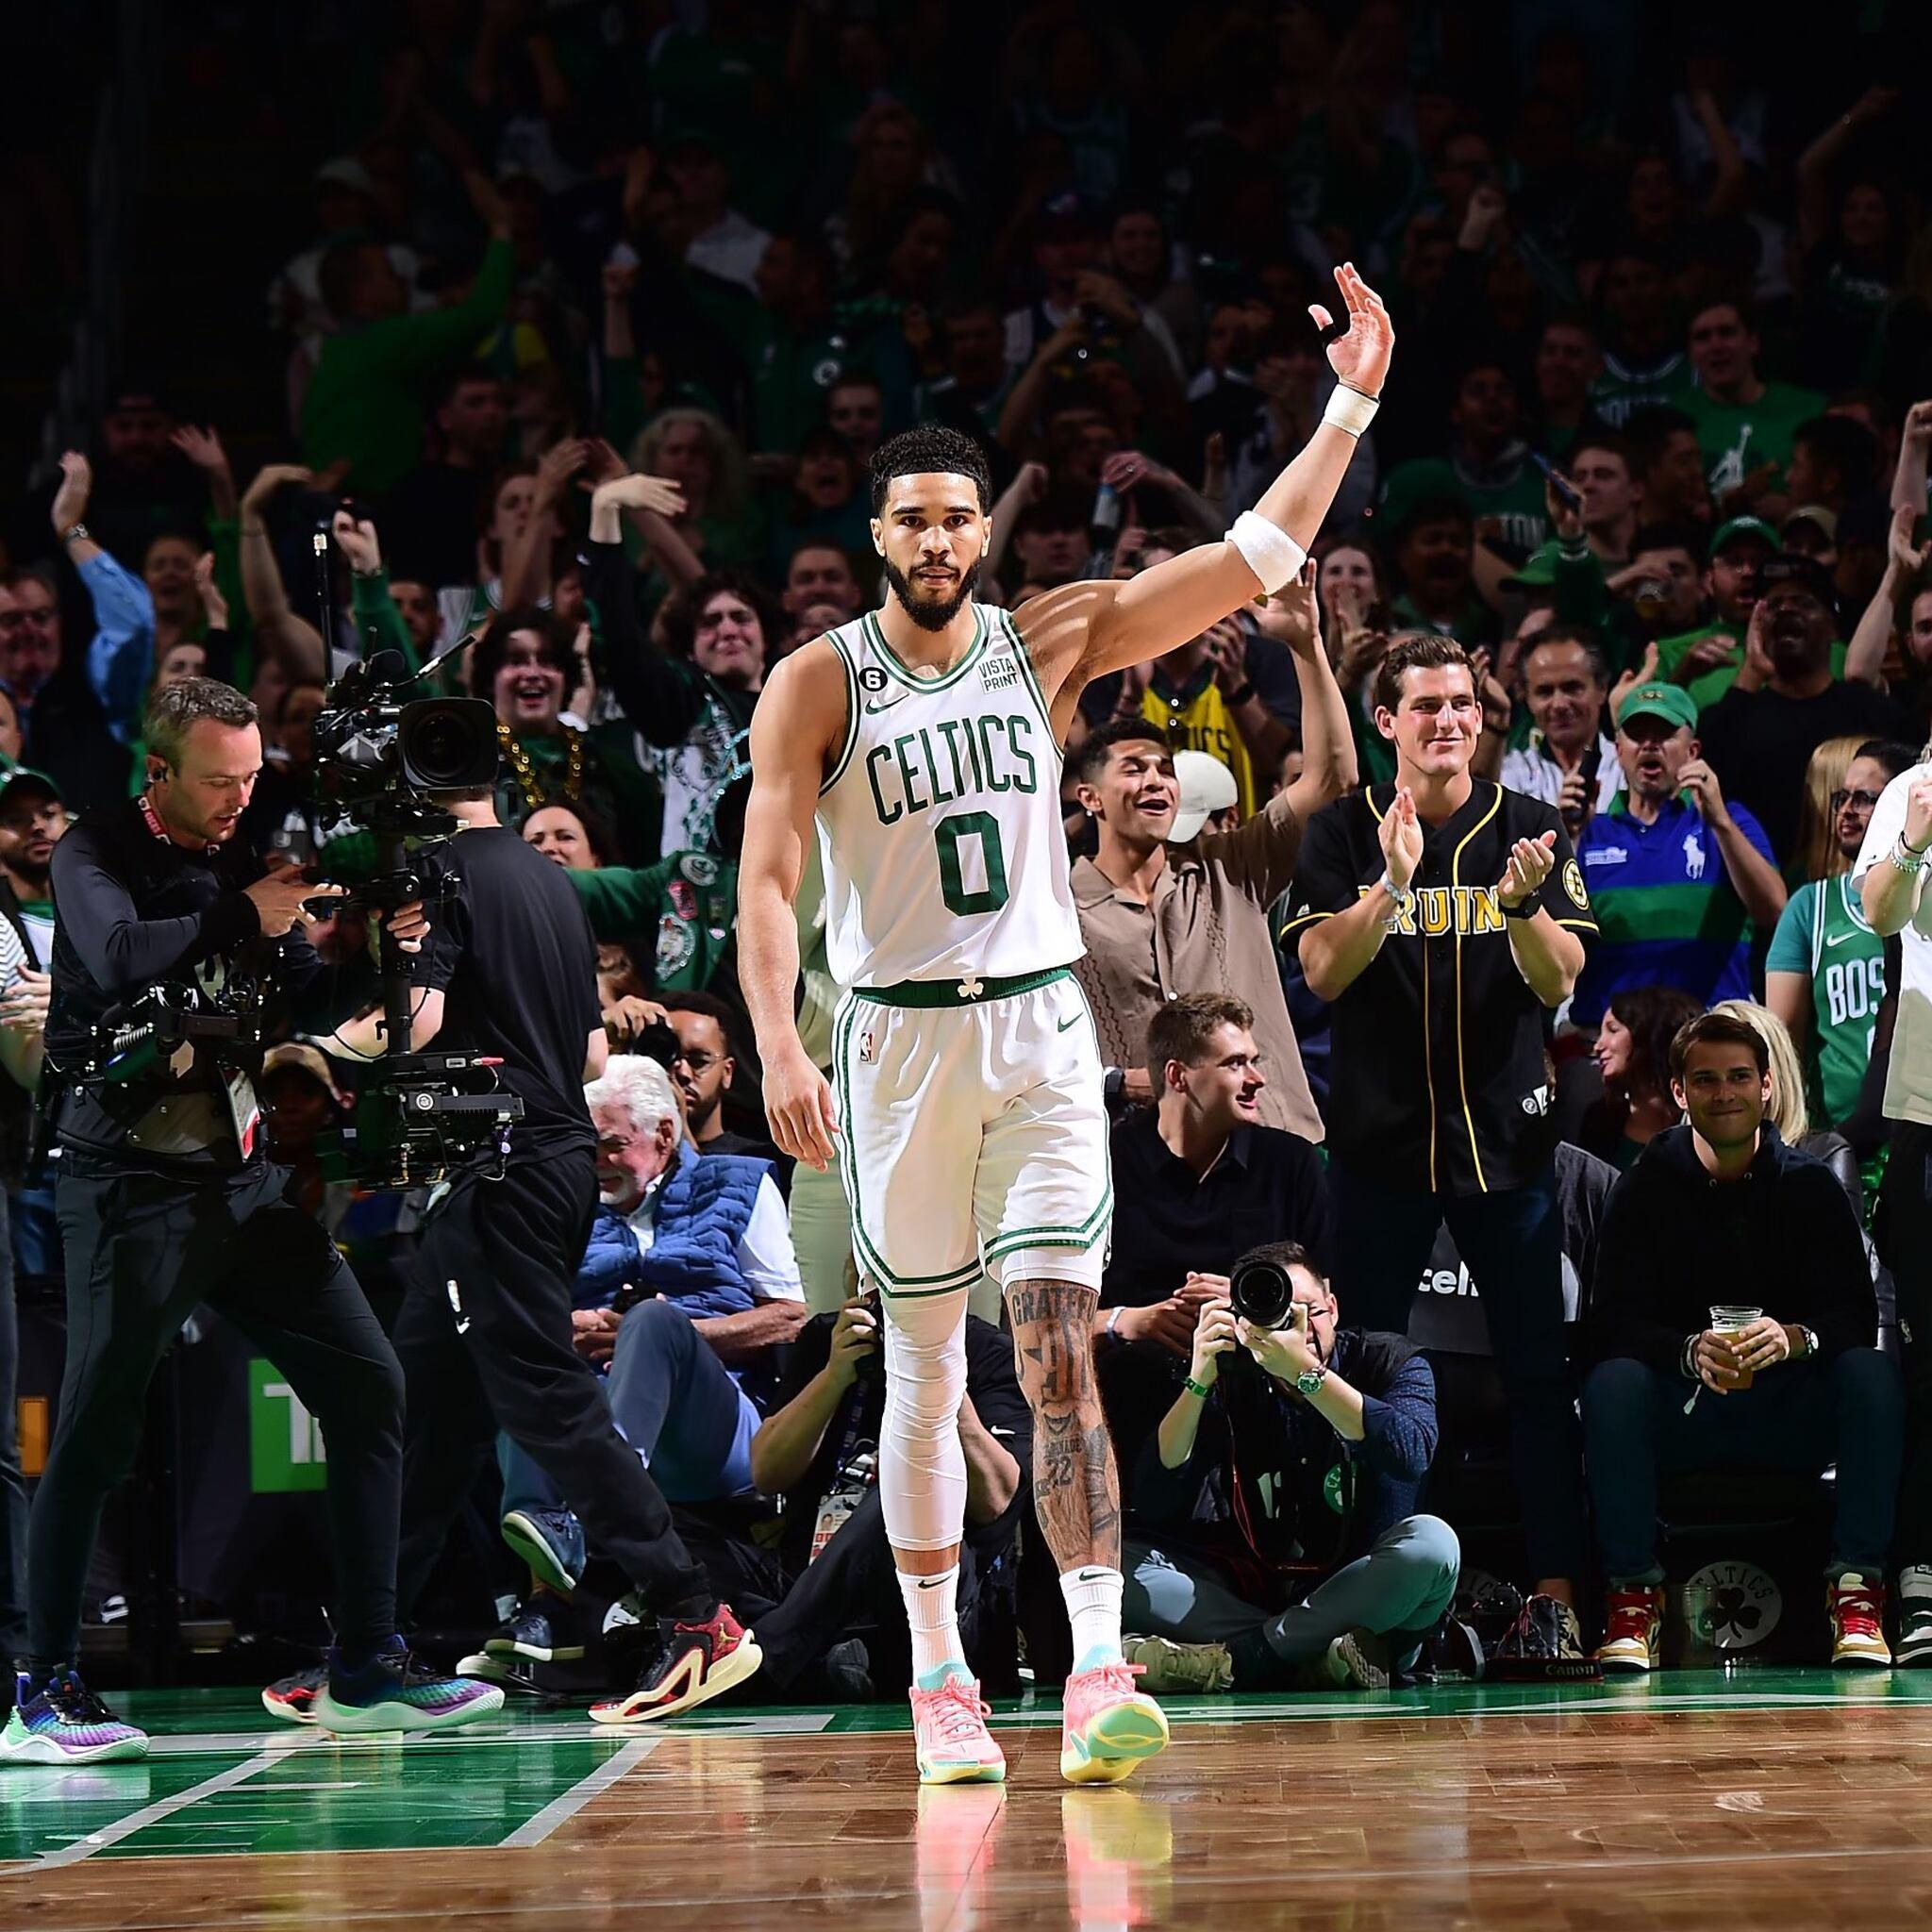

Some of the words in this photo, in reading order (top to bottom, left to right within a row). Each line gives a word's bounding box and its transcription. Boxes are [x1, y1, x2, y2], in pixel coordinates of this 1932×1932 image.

[978, 658, 1016, 678] VISTA
[865, 672, 881, 689] 6
[984, 673, 1019, 691] PRINT
[865, 714, 1038, 825] CELTICS
[934, 810, 1009, 917] 0
[1544, 1663, 1595, 1676] Canon
